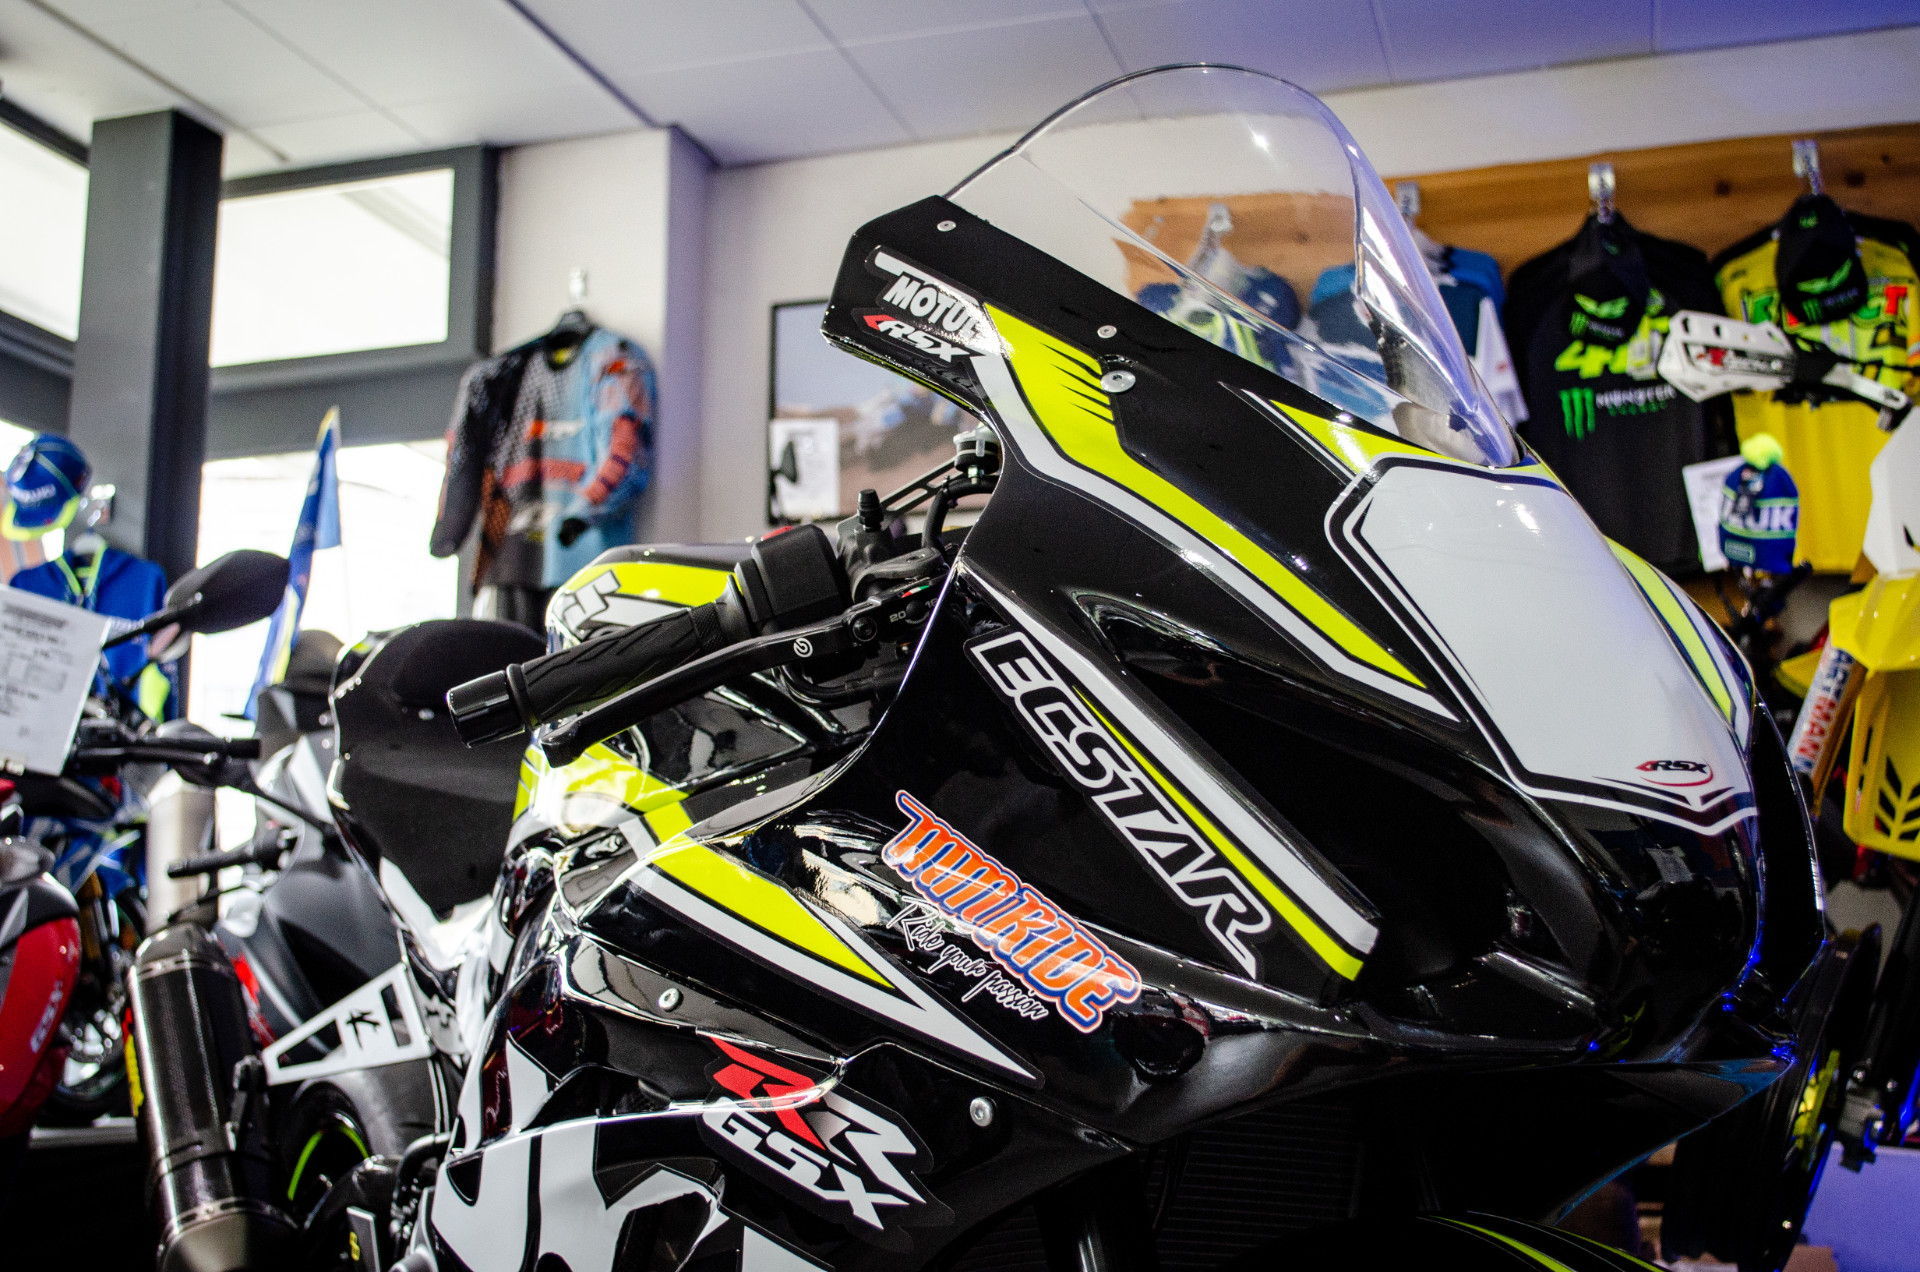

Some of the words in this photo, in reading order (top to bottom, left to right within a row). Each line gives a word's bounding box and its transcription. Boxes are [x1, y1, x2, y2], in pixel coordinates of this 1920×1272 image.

[863, 312, 971, 362] RSX
[970, 631, 1272, 980] ECSTAR
[1634, 759, 1707, 775] RSX
[886, 896, 945, 951] Ride
[927, 944, 987, 977] your
[961, 970, 1049, 1021] passion
[702, 1096, 910, 1231] GSX
